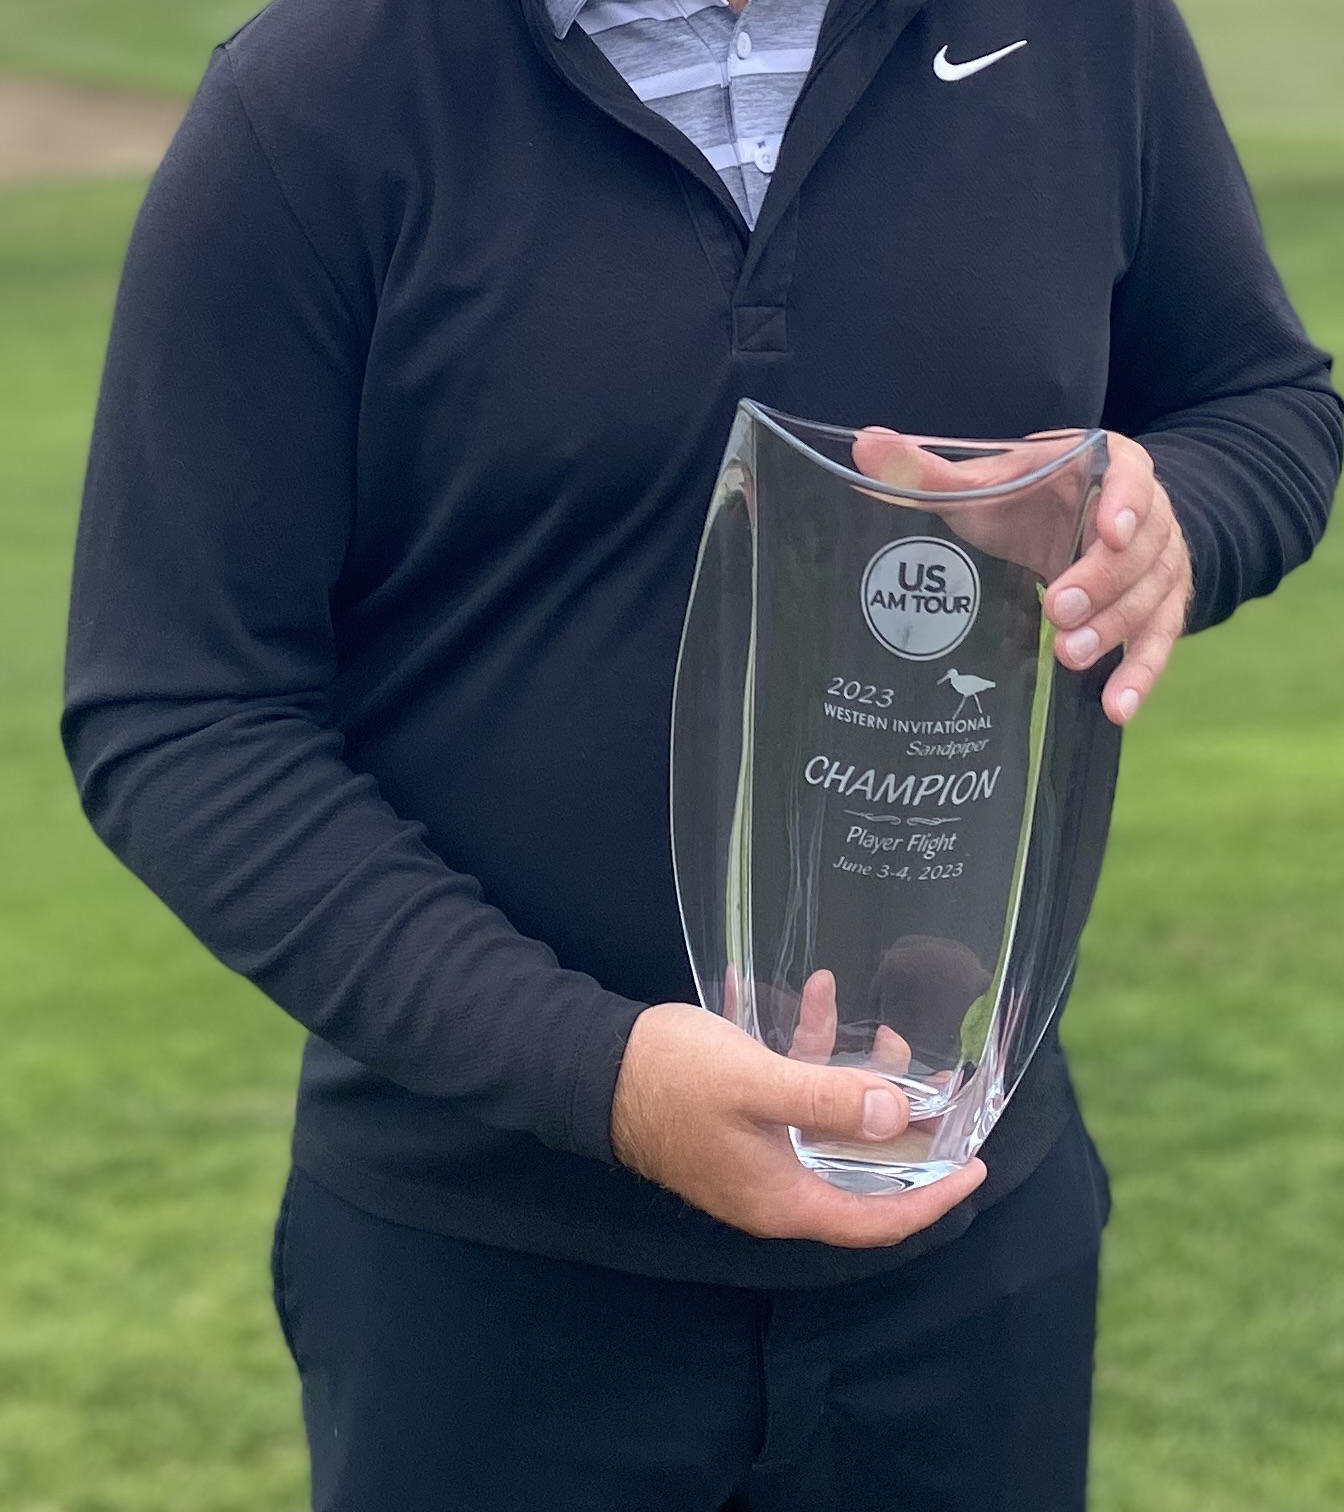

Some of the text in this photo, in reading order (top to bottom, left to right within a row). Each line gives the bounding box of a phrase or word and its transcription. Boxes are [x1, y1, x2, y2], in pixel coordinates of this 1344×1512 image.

[870, 590, 972, 614] AM TOUR
[827, 677, 895, 708] 2023
[824, 702, 993, 734] WESTERN INVITATIONAL
[906, 738, 990, 760] Sandpiper
[804, 755, 1002, 806] CHAMPION
[846, 826, 958, 860] Player Flight
[833, 856, 964, 882] June 3-4, 2023
